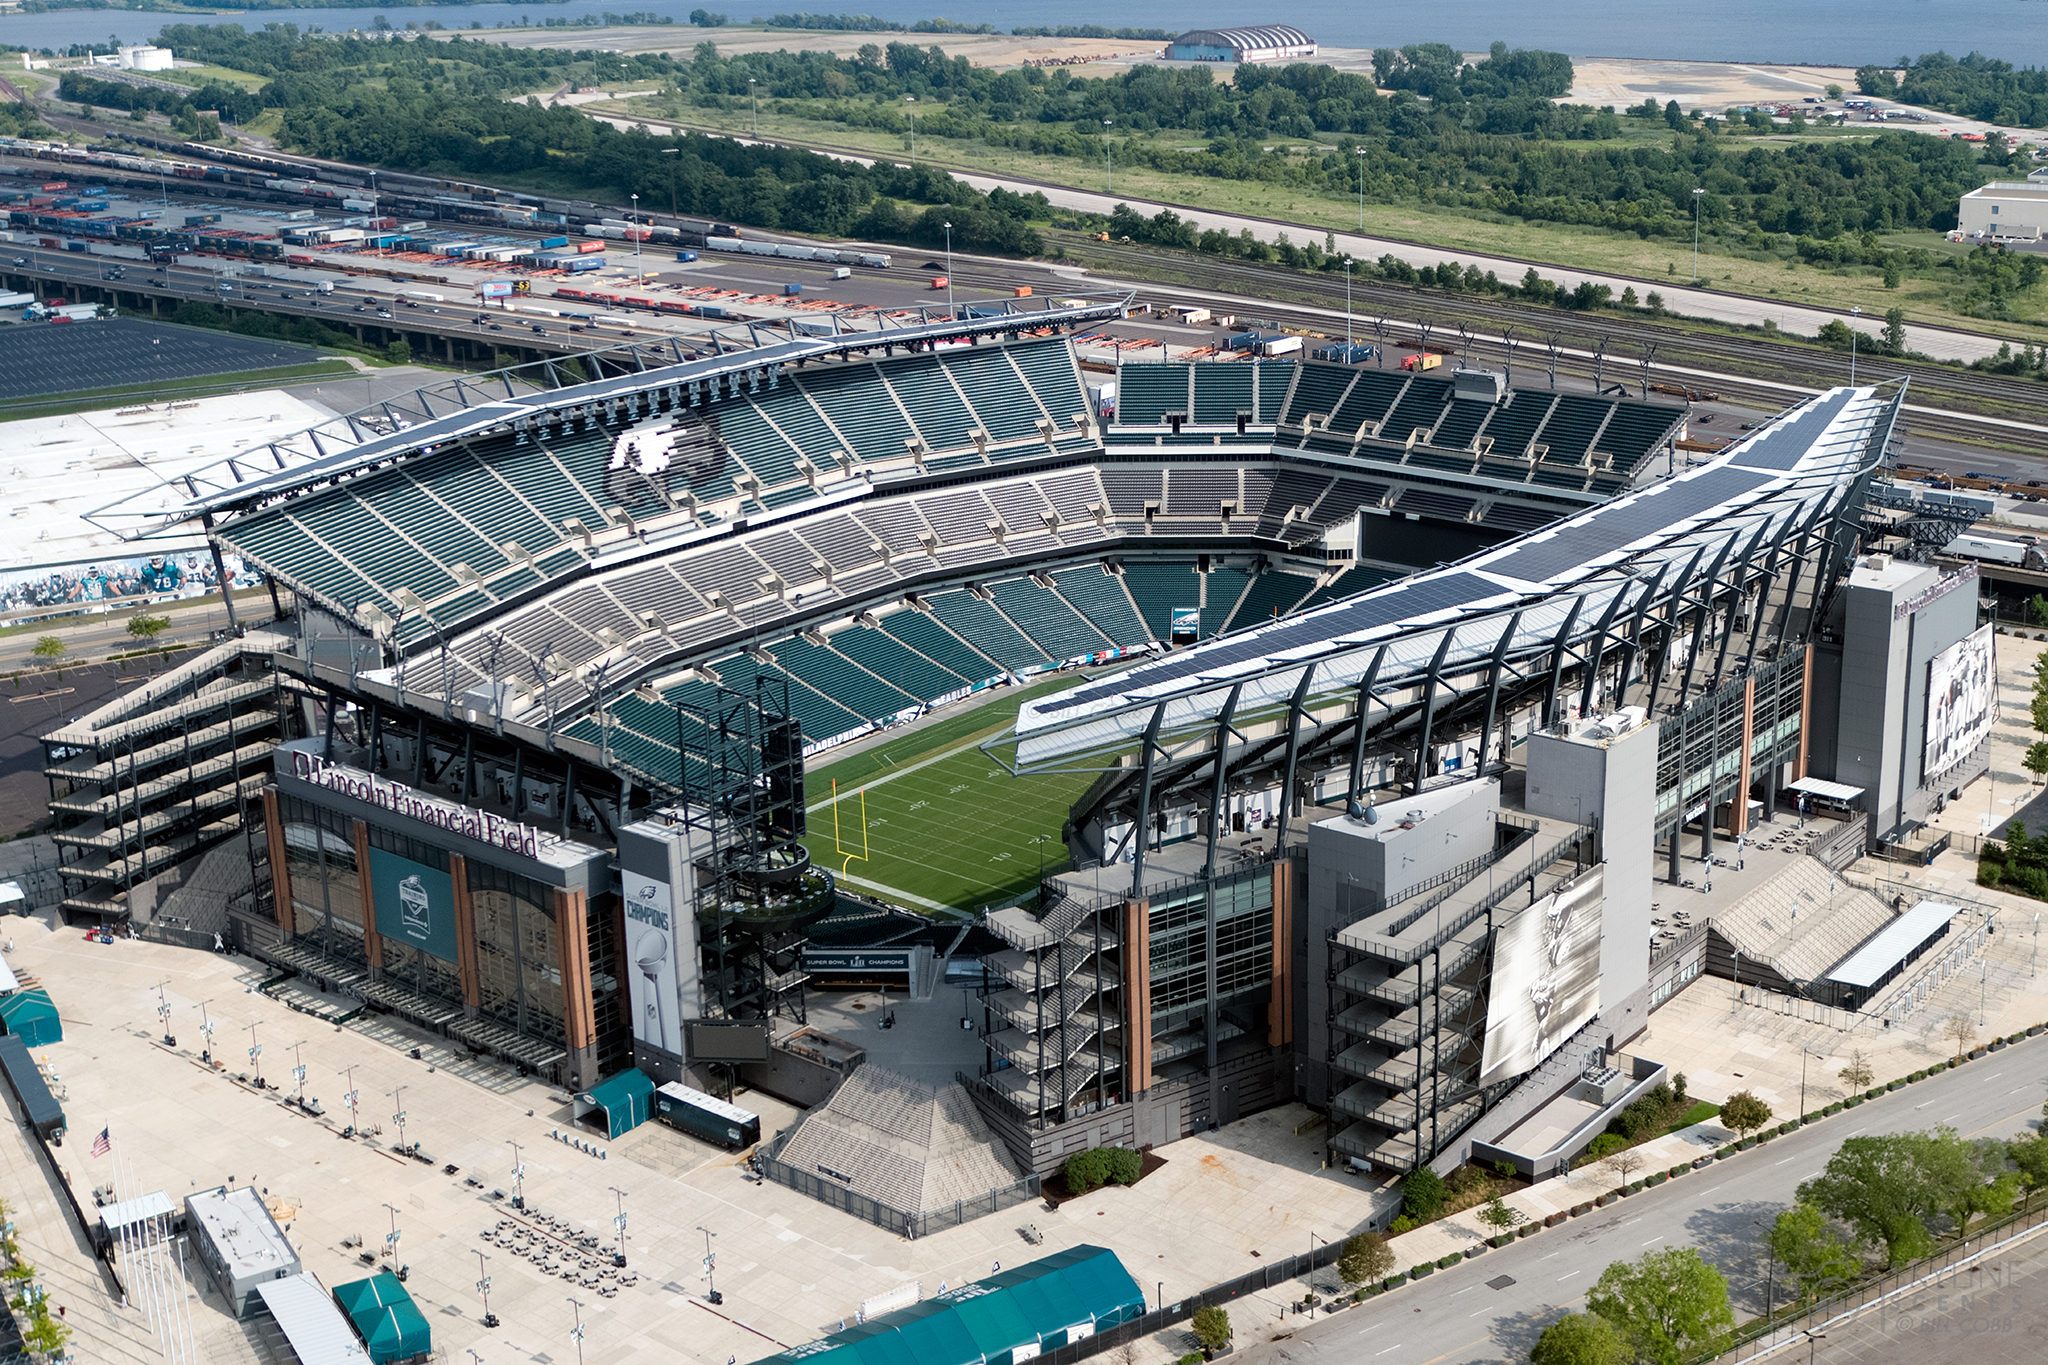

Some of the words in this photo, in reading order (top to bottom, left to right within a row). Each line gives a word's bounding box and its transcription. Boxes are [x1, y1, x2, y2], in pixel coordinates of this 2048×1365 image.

[803, 728, 861, 758] HILADELPHIA
[940, 685, 972, 703] EAGLES
[313, 755, 388, 809] Lincoln
[390, 780, 484, 841] Financial
[484, 811, 539, 860] Field
[627, 900, 669, 931] CHAMPIONS
